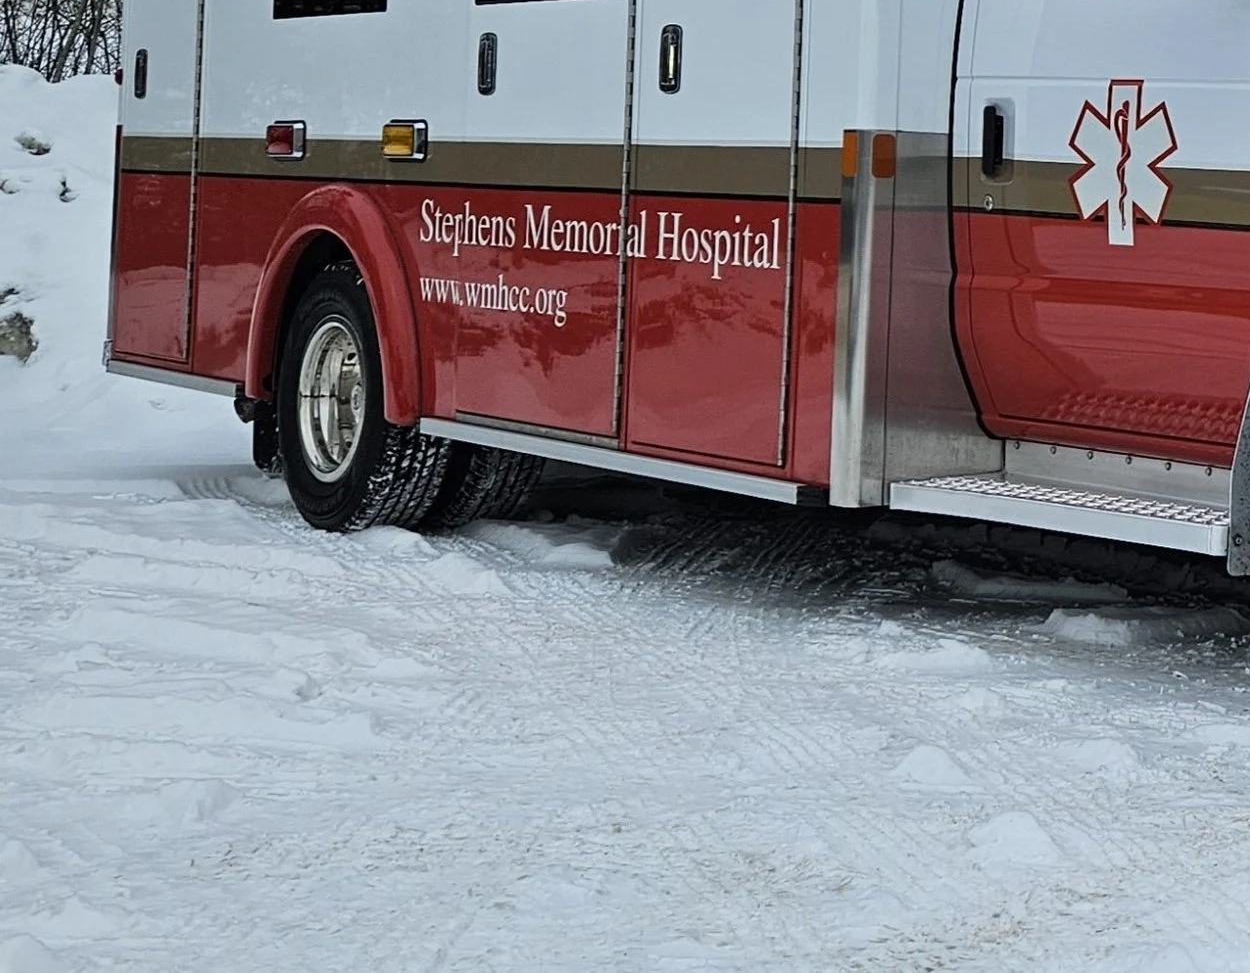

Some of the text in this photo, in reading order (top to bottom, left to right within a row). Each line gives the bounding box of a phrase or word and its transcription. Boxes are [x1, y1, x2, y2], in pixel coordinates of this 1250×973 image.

[419, 198, 782, 280] Stephens Memorial Hospital
[419, 273, 568, 328] www.wmhcc.org
